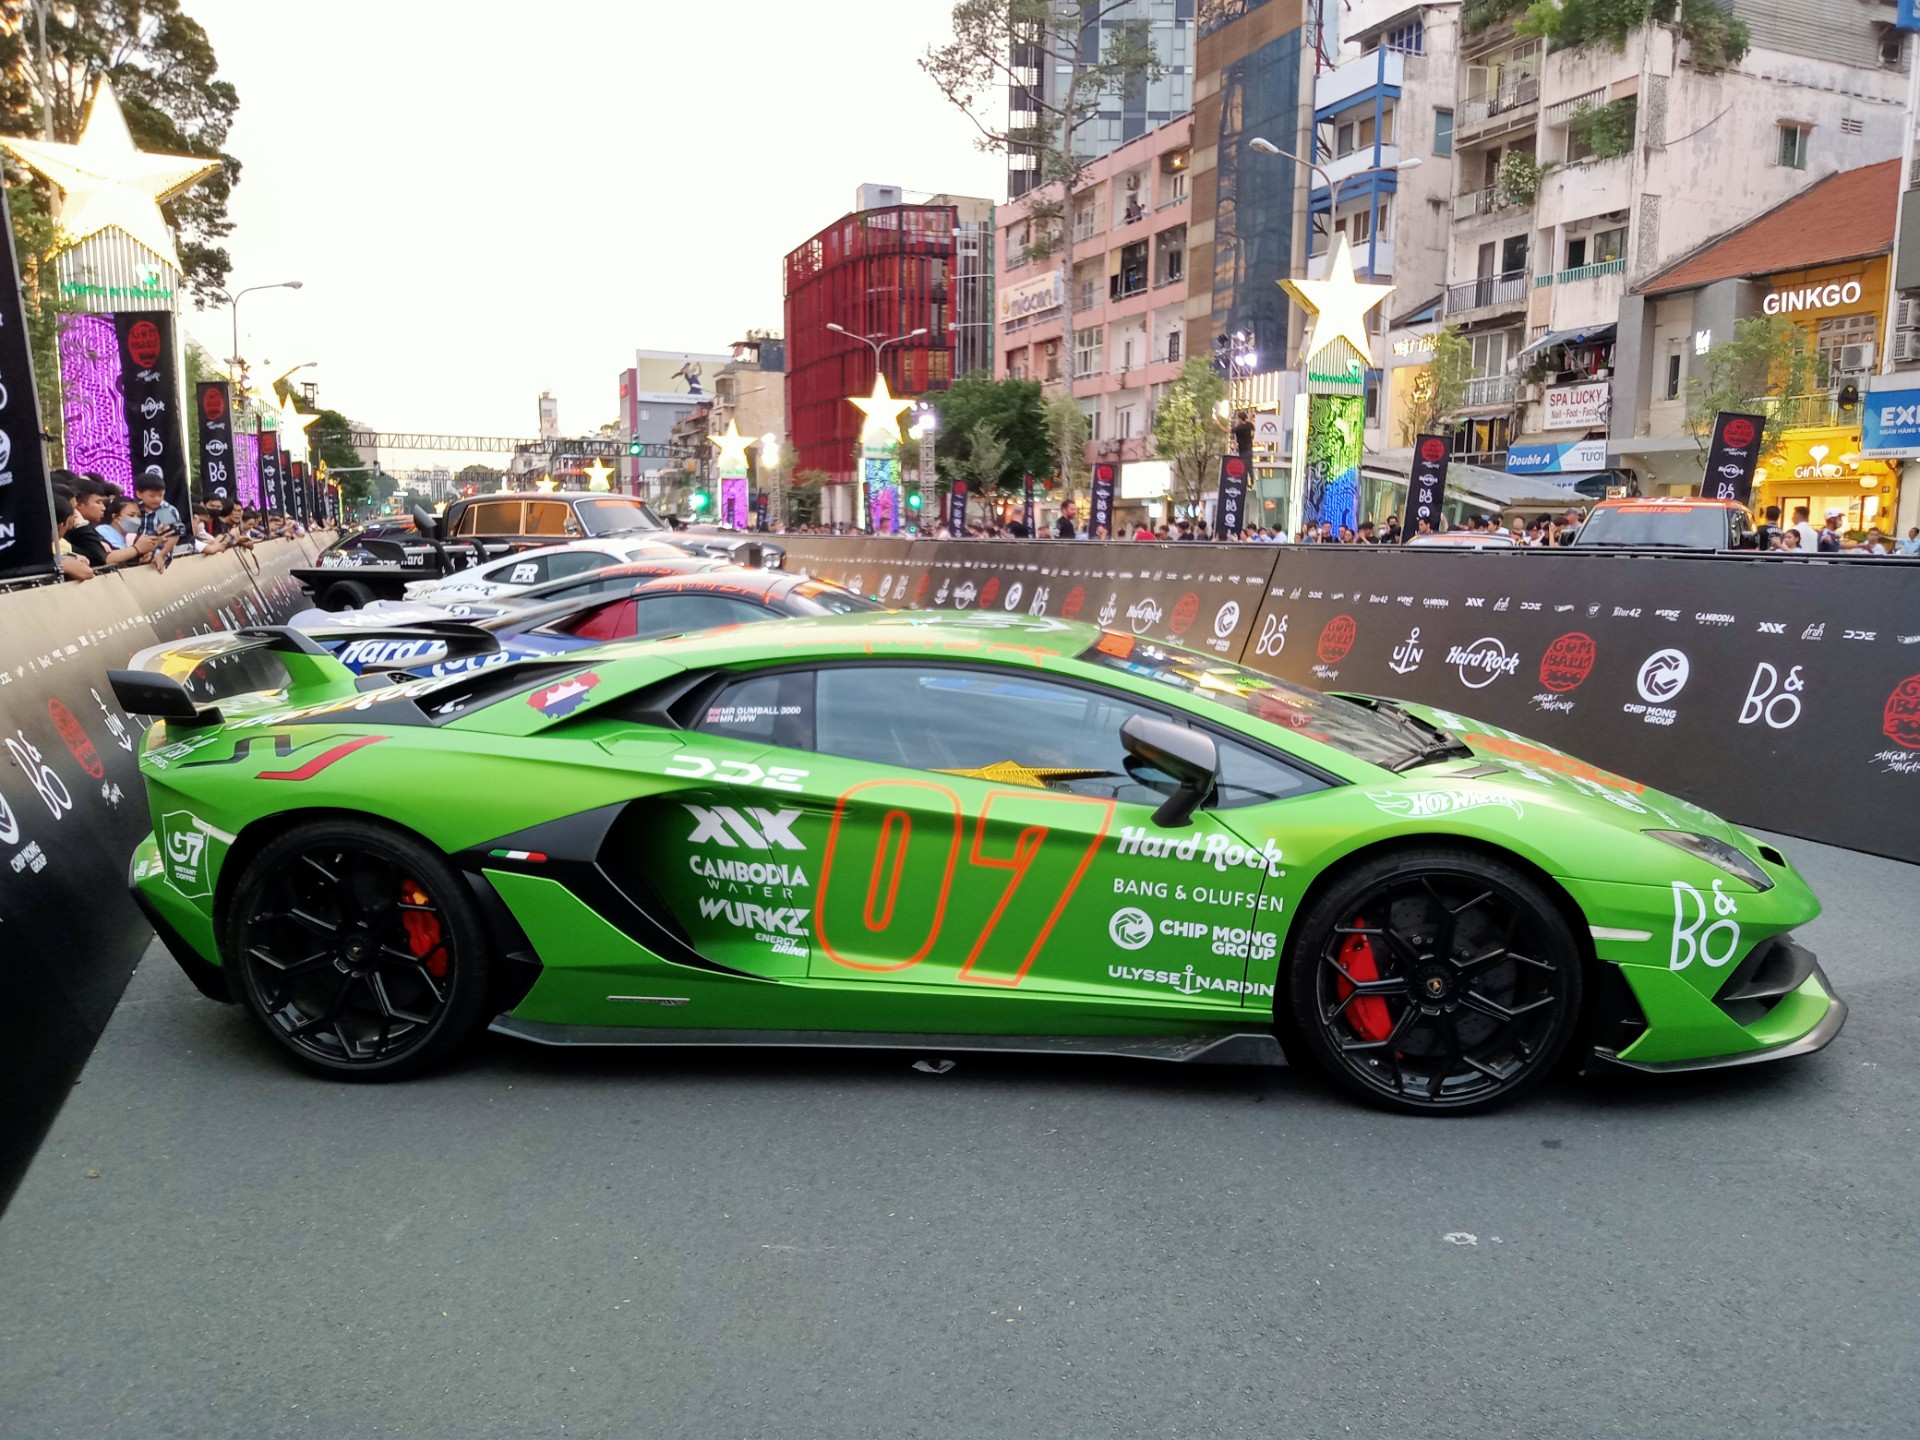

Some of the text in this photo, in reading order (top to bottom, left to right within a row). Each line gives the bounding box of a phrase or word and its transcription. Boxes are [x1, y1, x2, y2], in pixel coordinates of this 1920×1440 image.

[1763, 281, 1861, 315] GINKGO
[1550, 389, 1602, 407] SPA LUCKY
[1566, 408, 1578, 418] Foot
[1508, 453, 1551, 466] Double A
[1695, 612, 1735, 623] CAMBODIA
[1255, 613, 1289, 657] B&O
[1553, 640, 1593, 655] GUM
[1445, 646, 1520, 676] Hard Rock
[1738, 661, 1805, 729] B&O
[720, 714, 757, 723] MR JWW
[721, 707, 735, 715] MR
[737, 706, 779, 716] GUMBALL
[1623, 703, 1677, 719] CHIP MONG
[1644, 715, 1675, 726] GROUP
[5, 729, 73, 821] B&O
[1406, 790, 1449, 816] HOT
[167, 831, 204, 868] G7
[1116, 826, 1203, 861] Hard
[174, 864, 198, 876] INSTANT
[175, 872, 197, 884] COFFEE
[689, 854, 810, 887] CAMBODIA
[706, 879, 793, 900] WATER
[814, 777, 1118, 988] 07
[1113, 878, 1284, 913] BANG & OLUFSEN
[699, 896, 811, 937] WURKZ
[1669, 879, 1741, 971] B&O
[755, 932, 799, 946] ENERGY
[1159, 919, 1277, 948] CHIP MONG
[771, 943, 810, 958] DRINK
[1211, 941, 1276, 961] GROUP
[1108, 964, 1275, 997] ULYSSE NARDIN
